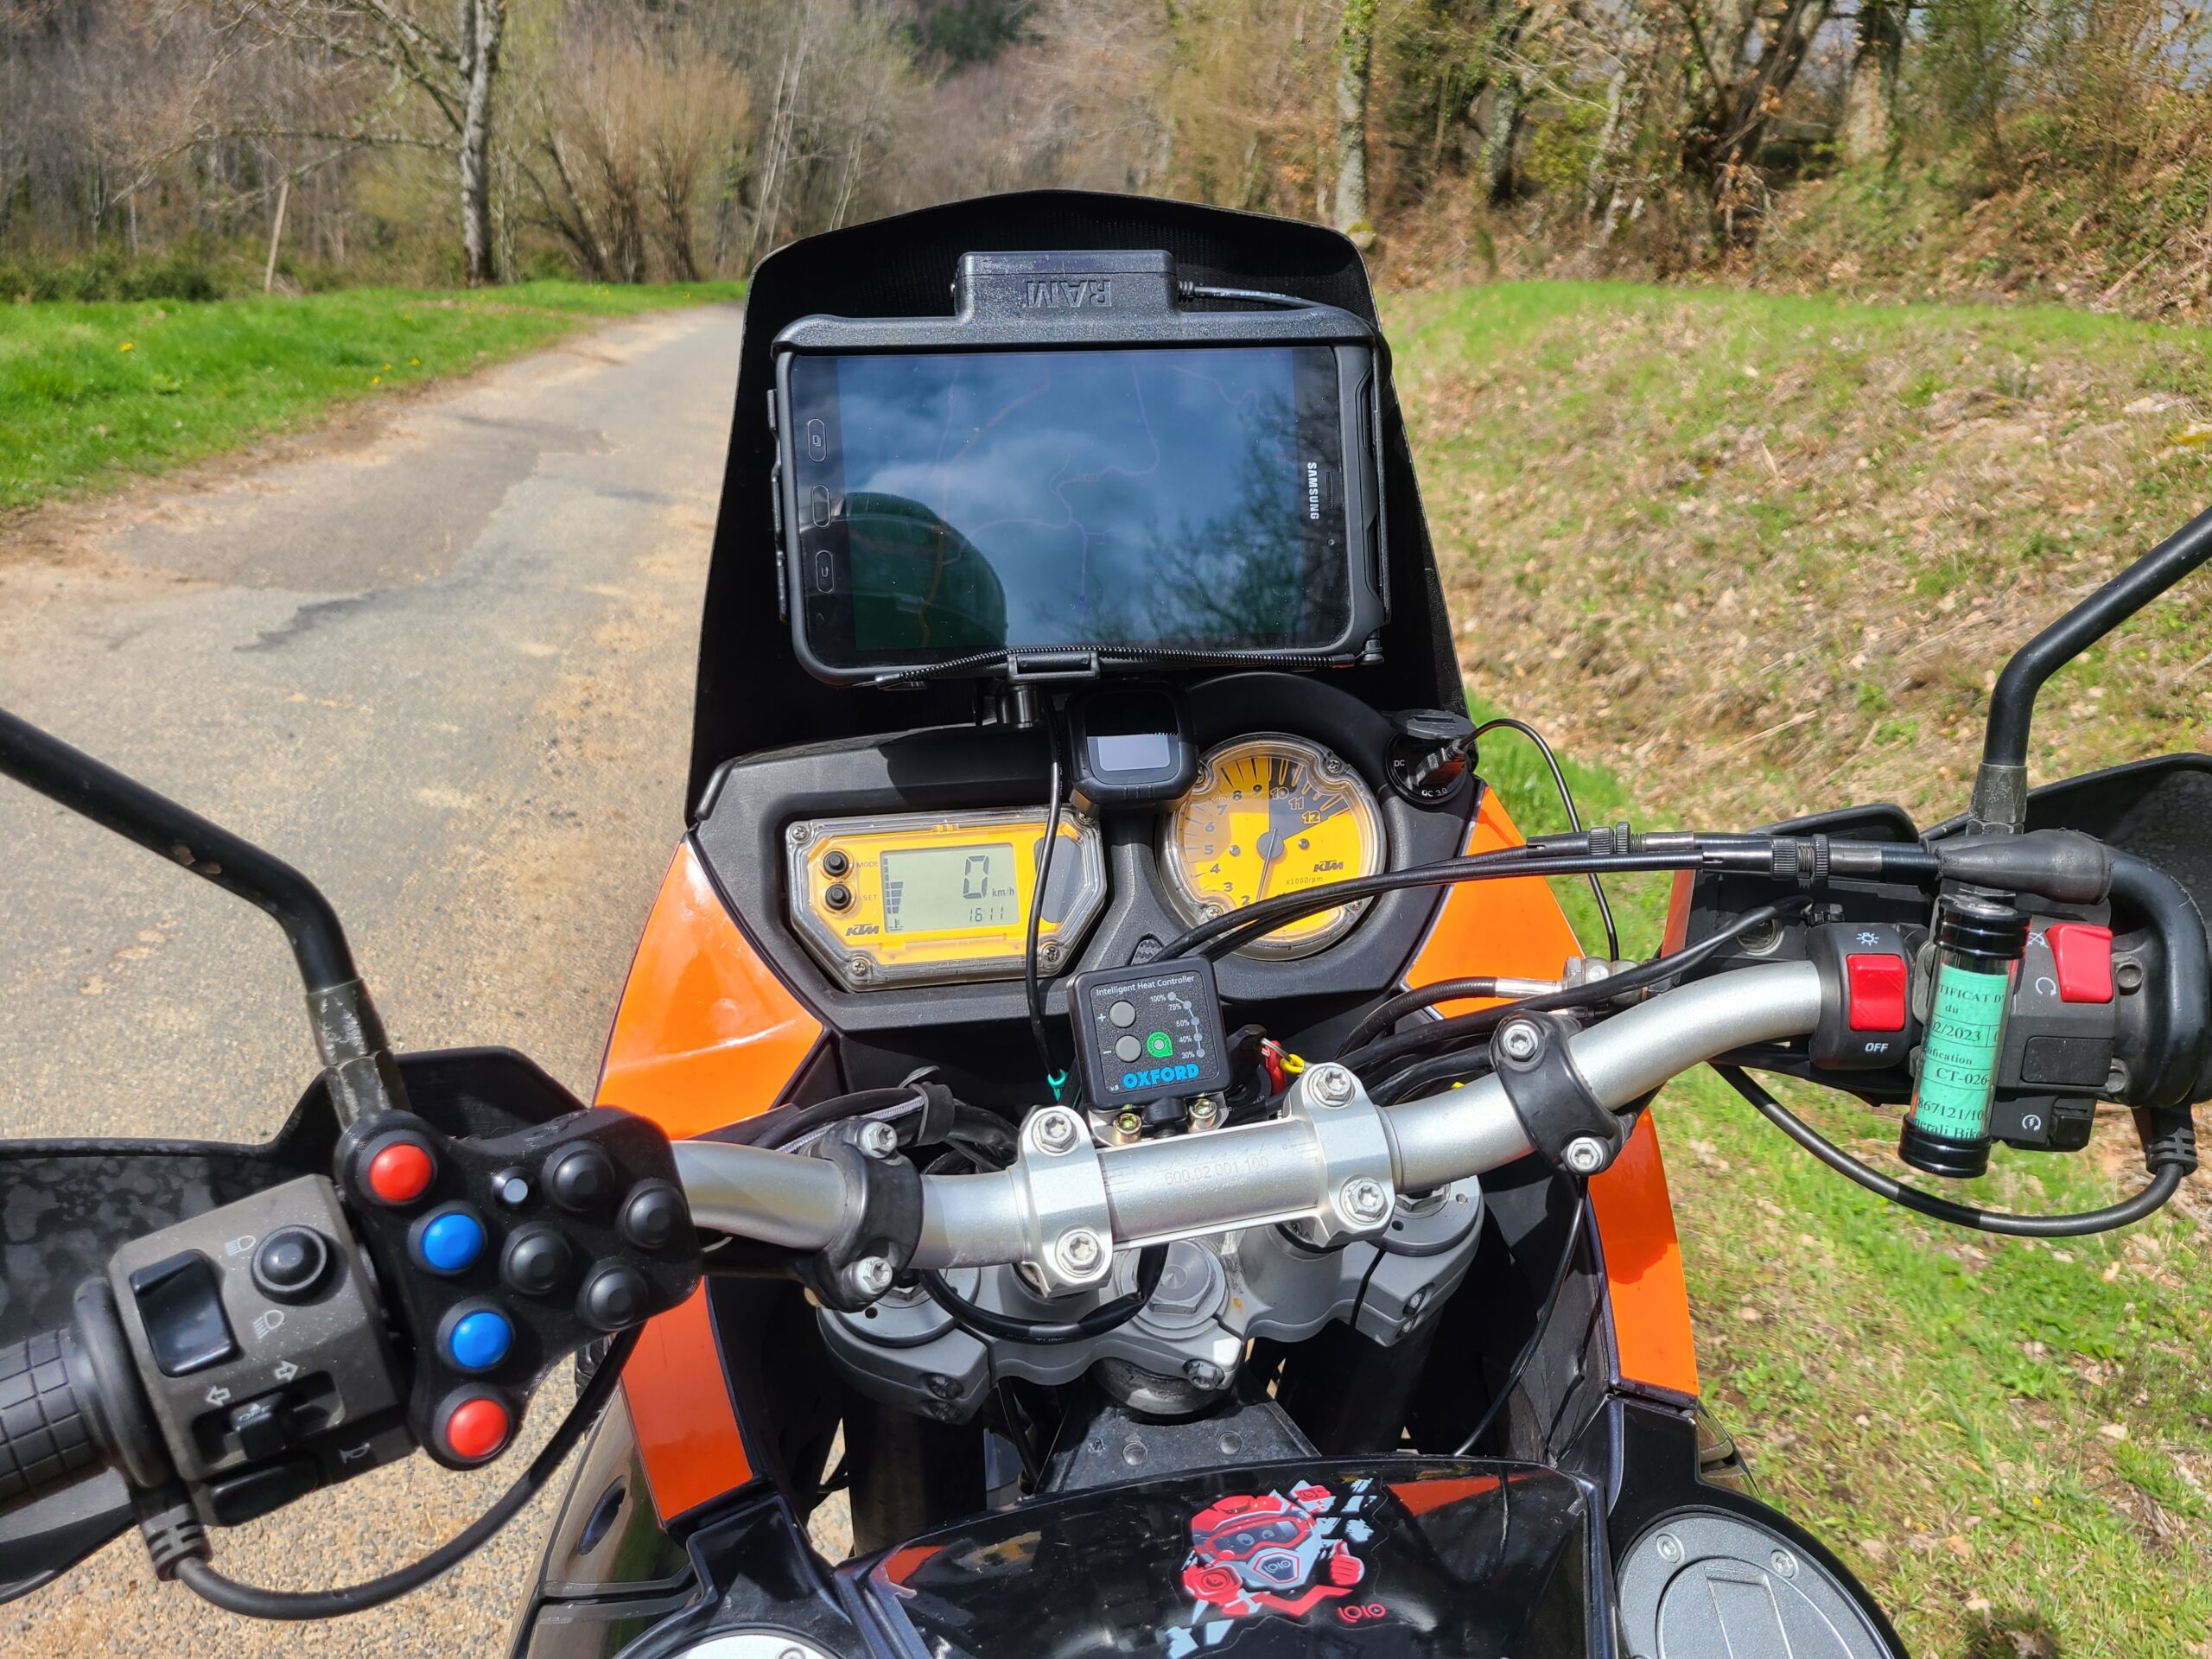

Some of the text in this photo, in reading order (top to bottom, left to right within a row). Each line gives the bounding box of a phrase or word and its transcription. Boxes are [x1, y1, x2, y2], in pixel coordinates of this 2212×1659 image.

[1026, 280, 1111, 308] RAM
[1307, 461, 1319, 519] SAMSUNG
[1270, 787, 1289, 799] 10
[1435, 787, 1447, 796] 3.0
[1288, 796, 1304, 810] 11
[1217, 804, 1227, 815] 7
[1301, 810, 1320, 823] 12
[1205, 822, 1215, 832] 6
[1205, 844, 1213, 855] 5
[1210, 863, 1220, 874] 4
[1313, 860, 1344, 872] KTM
[963, 855, 1014, 899] 0 km/h
[1224, 881, 1233, 892] 3
[1241, 895, 1250, 906] 2
[846, 924, 880, 936] KTM
[1096, 975, 1194, 995] Intelligent Heat Controller
[1150, 994, 1166, 1002] 100%
[1945, 1004, 1959, 1014] du
[1865, 1042, 1889, 1052] OFF
[1181, 1051, 1194, 1059] 30%
[1122, 1063, 1199, 1089] OXFORD
